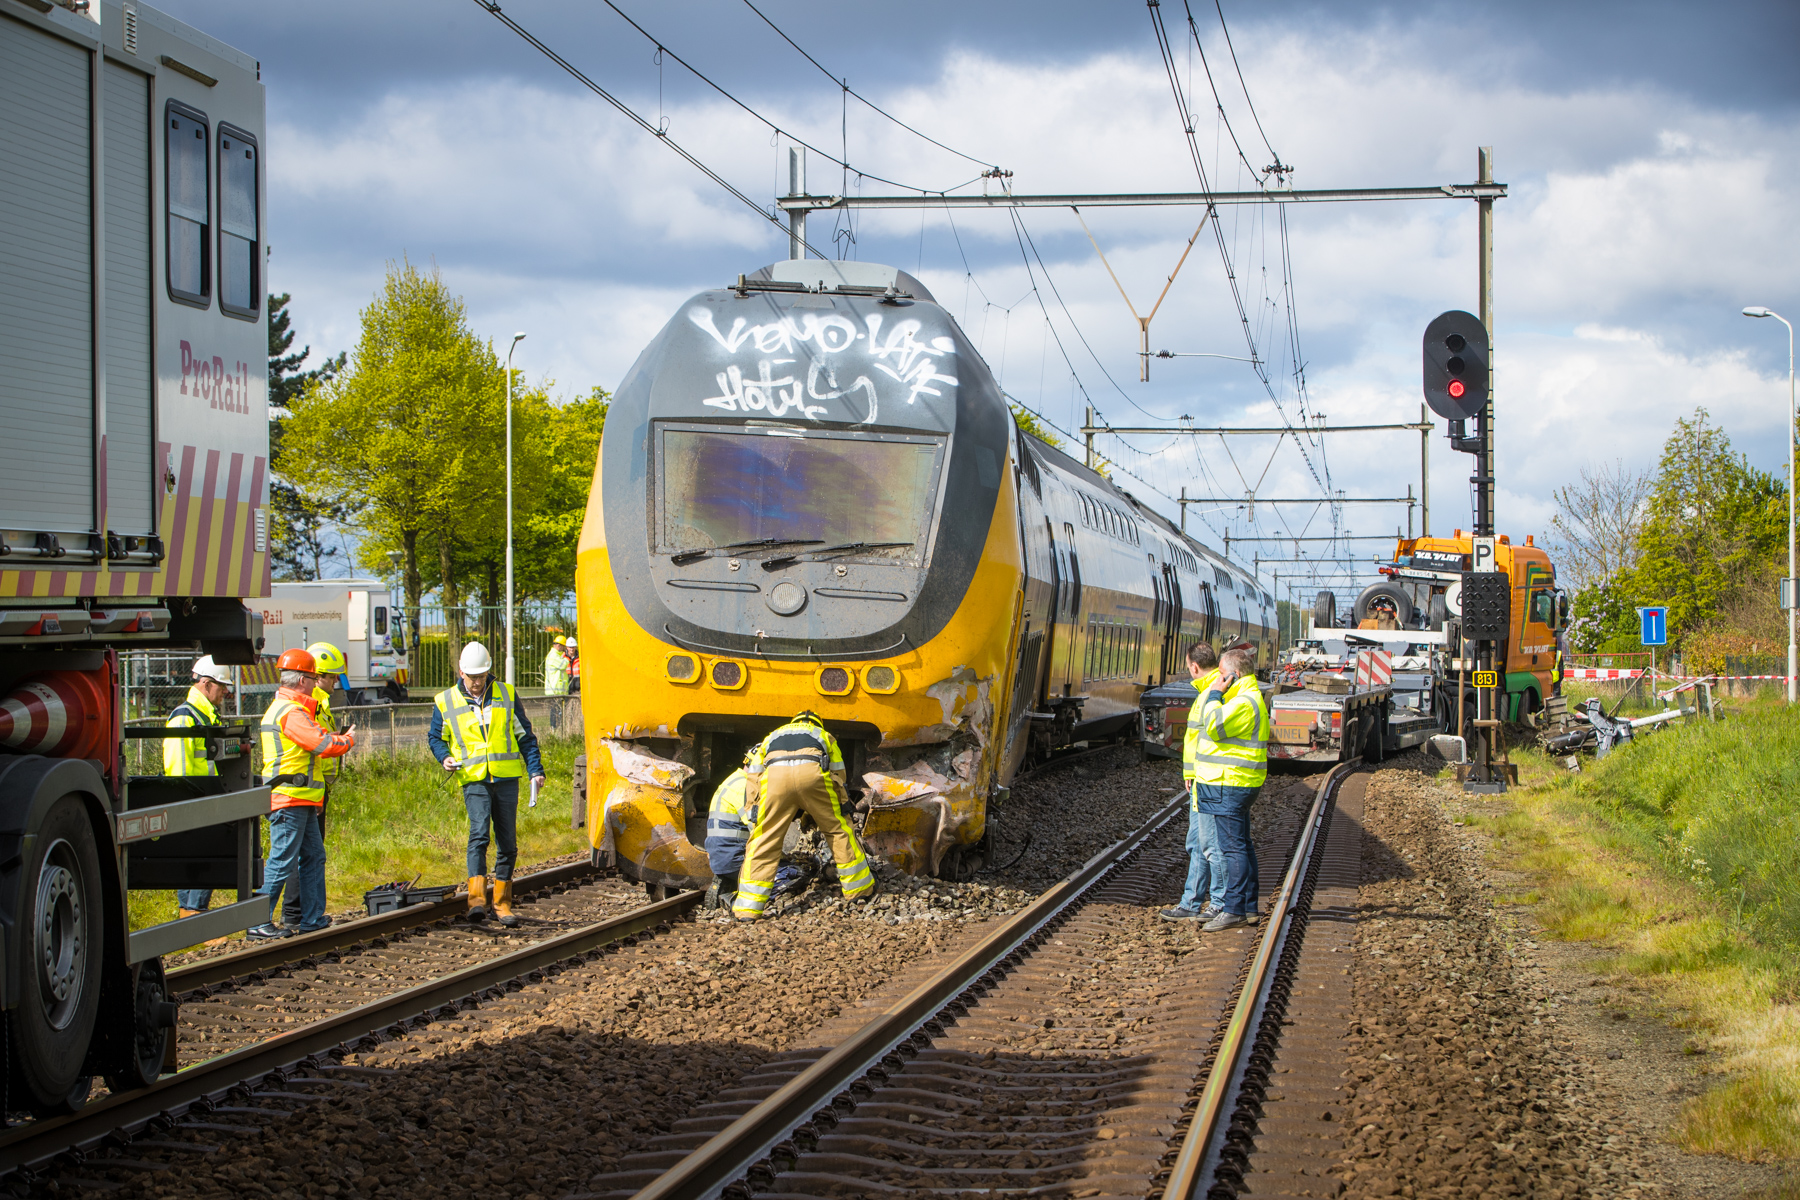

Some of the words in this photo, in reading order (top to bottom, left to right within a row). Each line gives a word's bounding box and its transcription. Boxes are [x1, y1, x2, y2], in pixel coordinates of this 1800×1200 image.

[179, 339, 249, 415] ProRail
[1432, 553, 1462, 562] VLIST
[1476, 544, 1492, 567] P
[247, 608, 283, 624] Rail
[292, 611, 342, 621] Incidentenbestrijding
[1477, 673, 1493, 685] 813
[1269, 728, 1304, 739] ONNEL
